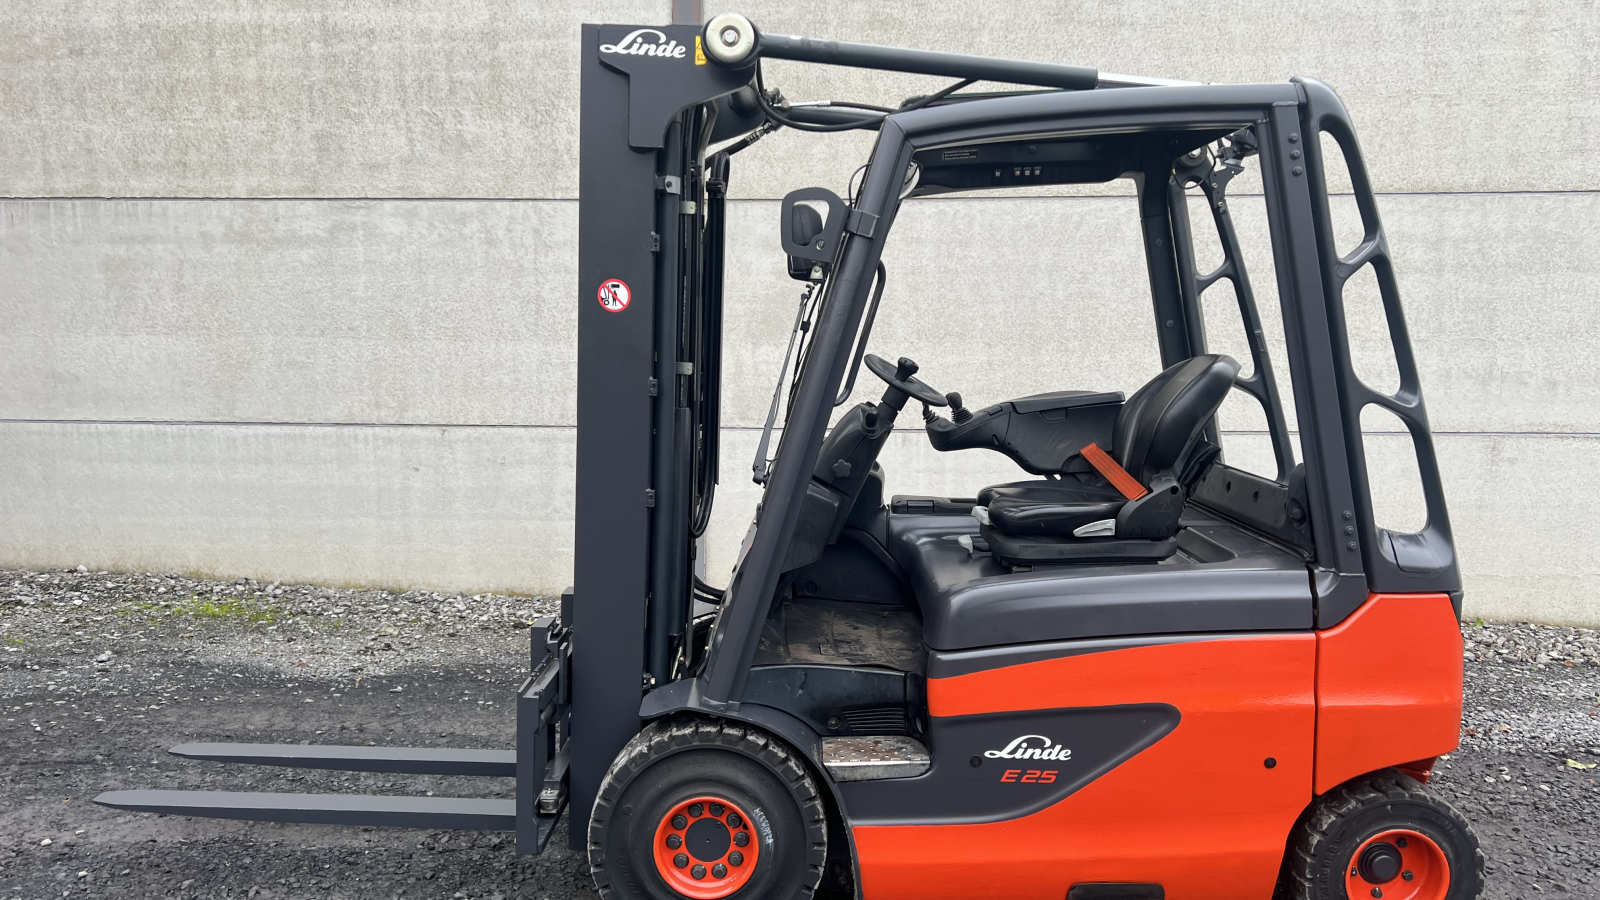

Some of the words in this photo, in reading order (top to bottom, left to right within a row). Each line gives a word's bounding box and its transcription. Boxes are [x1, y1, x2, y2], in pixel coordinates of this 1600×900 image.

[600, 28, 686, 59] Linde
[984, 734, 1072, 761] Linde
[1000, 769, 1022, 783] E
[1020, 769, 1059, 784] 25
